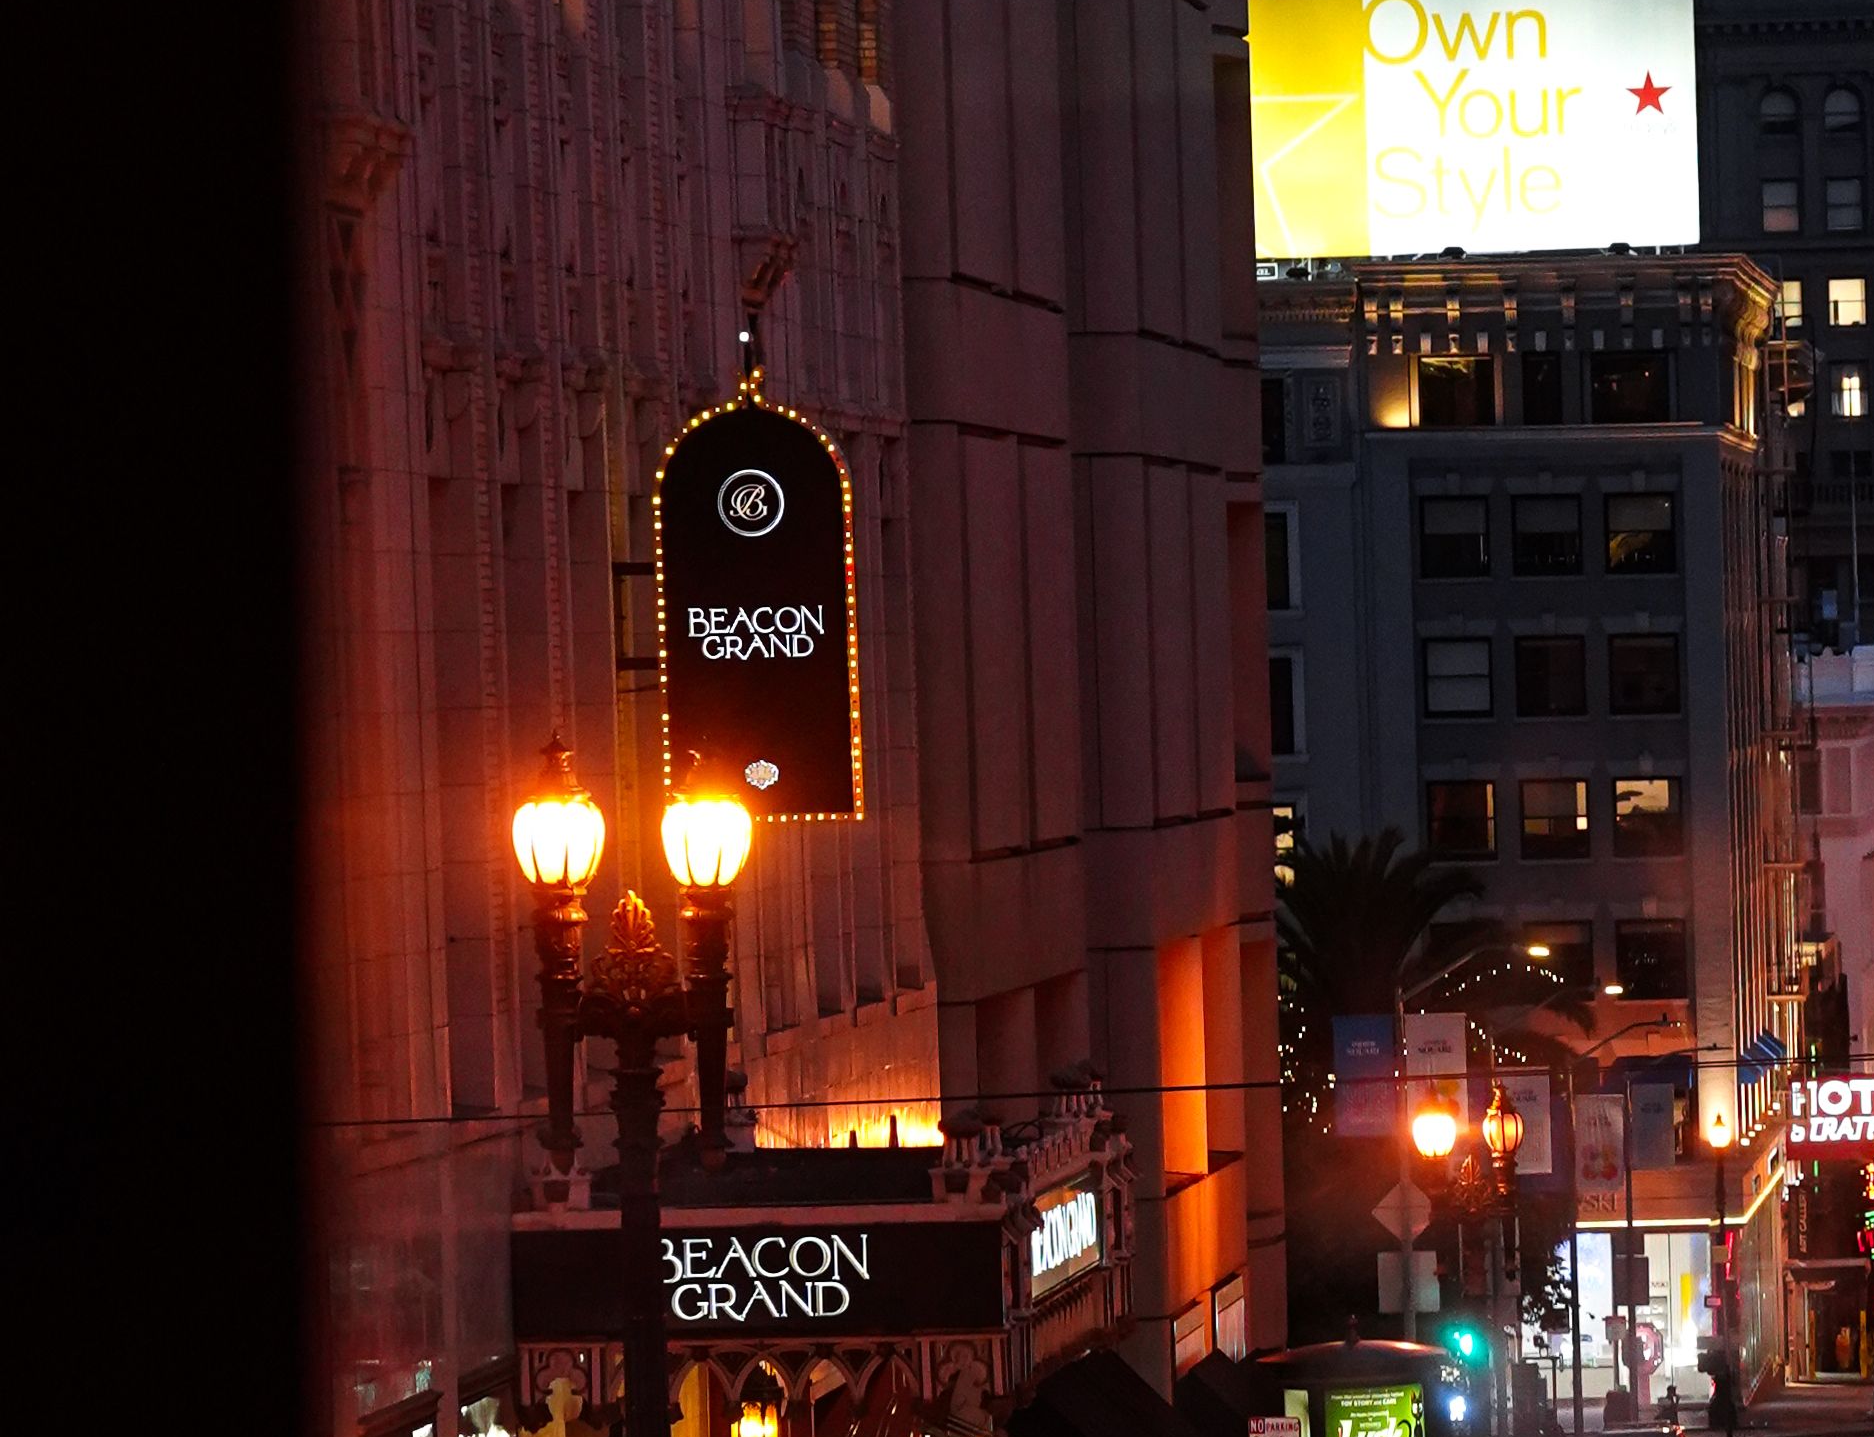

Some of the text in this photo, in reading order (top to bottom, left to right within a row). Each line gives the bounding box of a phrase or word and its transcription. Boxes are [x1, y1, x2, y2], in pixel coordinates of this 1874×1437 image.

[1414, 68, 1582, 140] Your
[1373, 145, 1563, 231] Style
[688, 605, 825, 637] BEACON
[702, 634, 814, 660] GRAND
[671, 1280, 850, 1322] GRAND
[1250, 1420, 1299, 1433] NO PARKING
